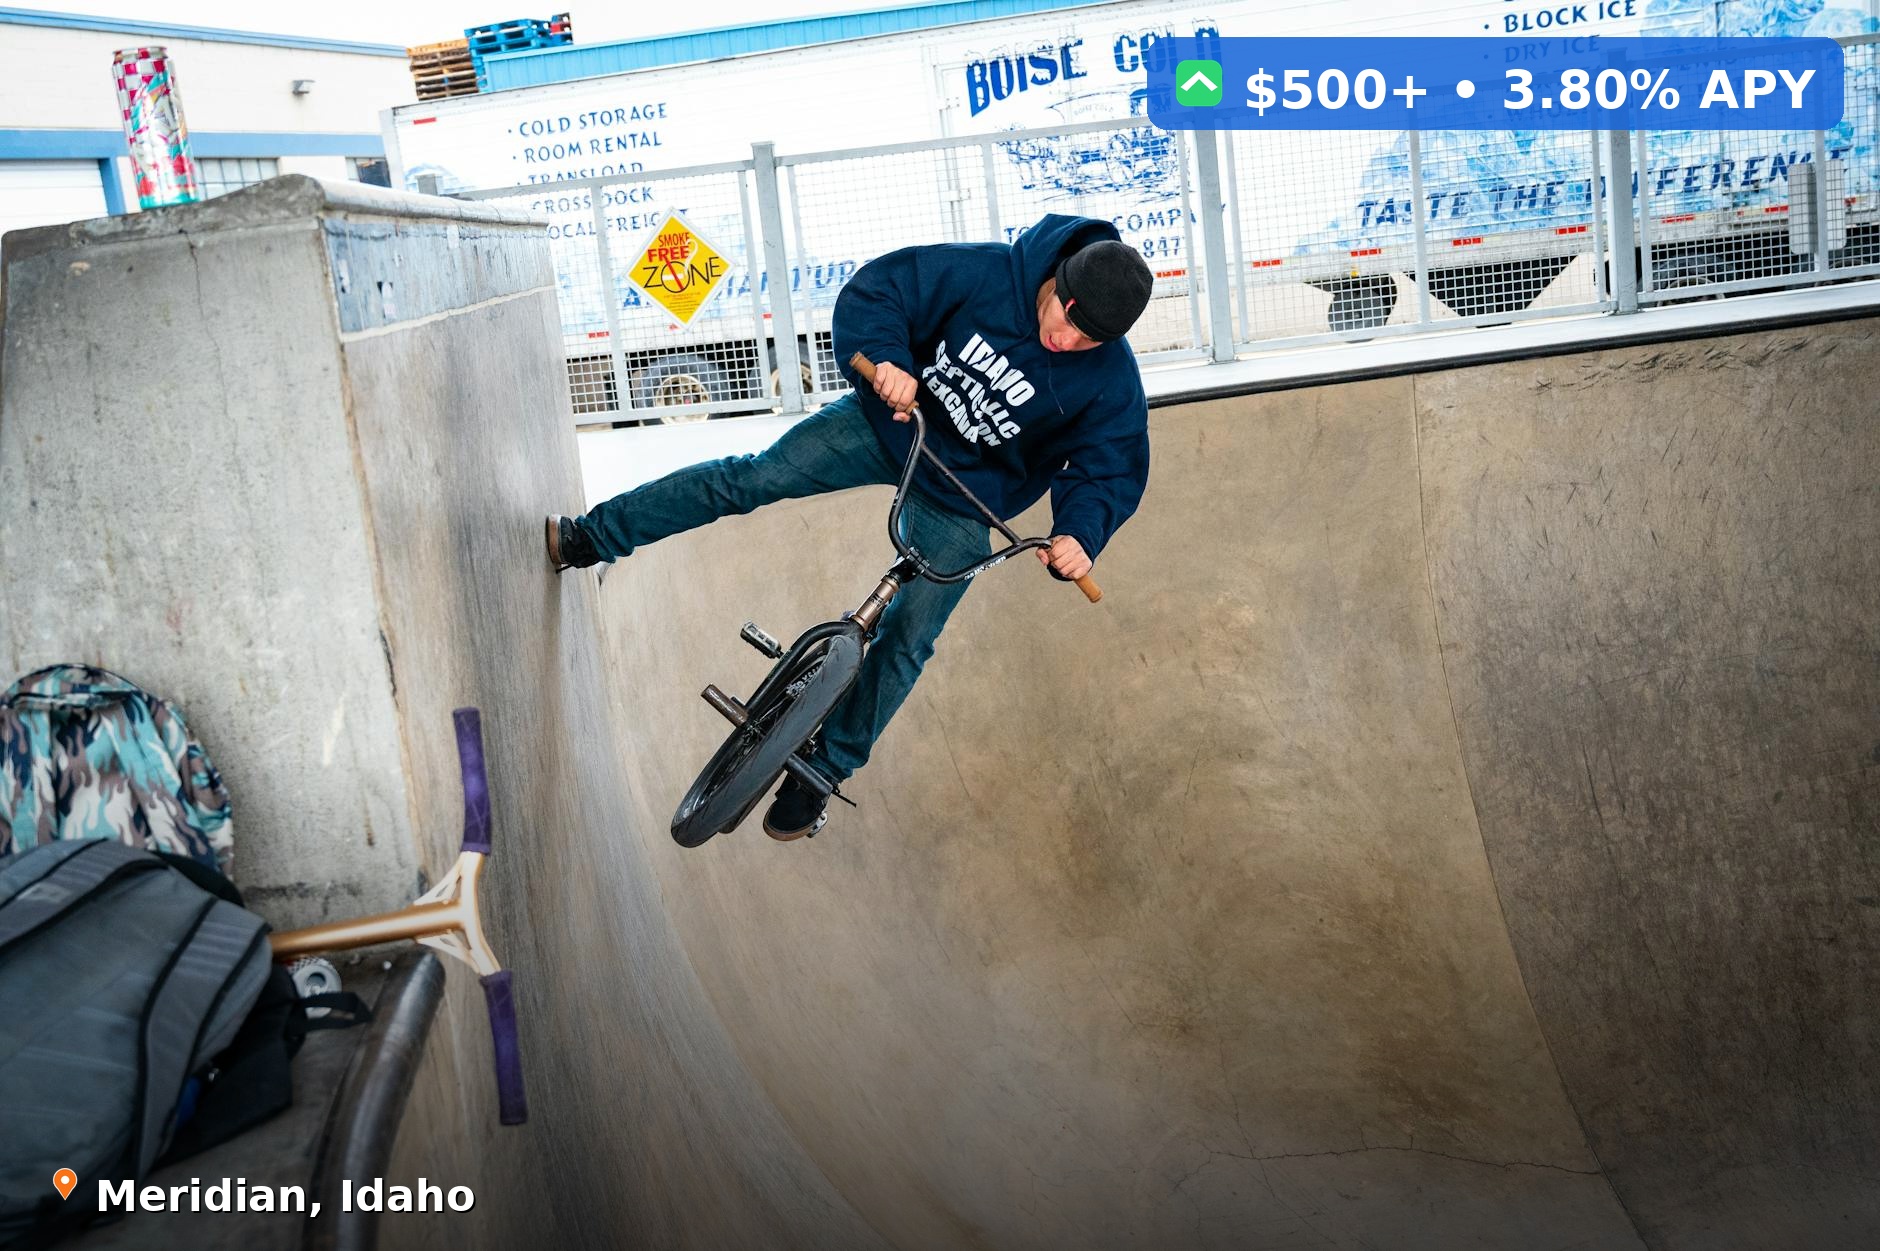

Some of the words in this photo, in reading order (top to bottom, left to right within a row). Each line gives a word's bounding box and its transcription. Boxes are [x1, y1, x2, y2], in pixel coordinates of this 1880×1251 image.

[1503, 6, 1587, 34] BLOCK
[1598, 0, 1638, 20] ICE
[965, 36, 1088, 118] BOISE
[519, 116, 571, 137] COLD
[579, 102, 668, 130] STORAGE
[524, 141, 582, 163] ROOM
[590, 131, 663, 154] RENTAL
[1487, 180, 1566, 214] THE
[548, 221, 596, 240] OCAL
[658, 232, 691, 248] SMOKE
[647, 246, 690, 263] FREE
[642, 256, 722, 294] ZONE
